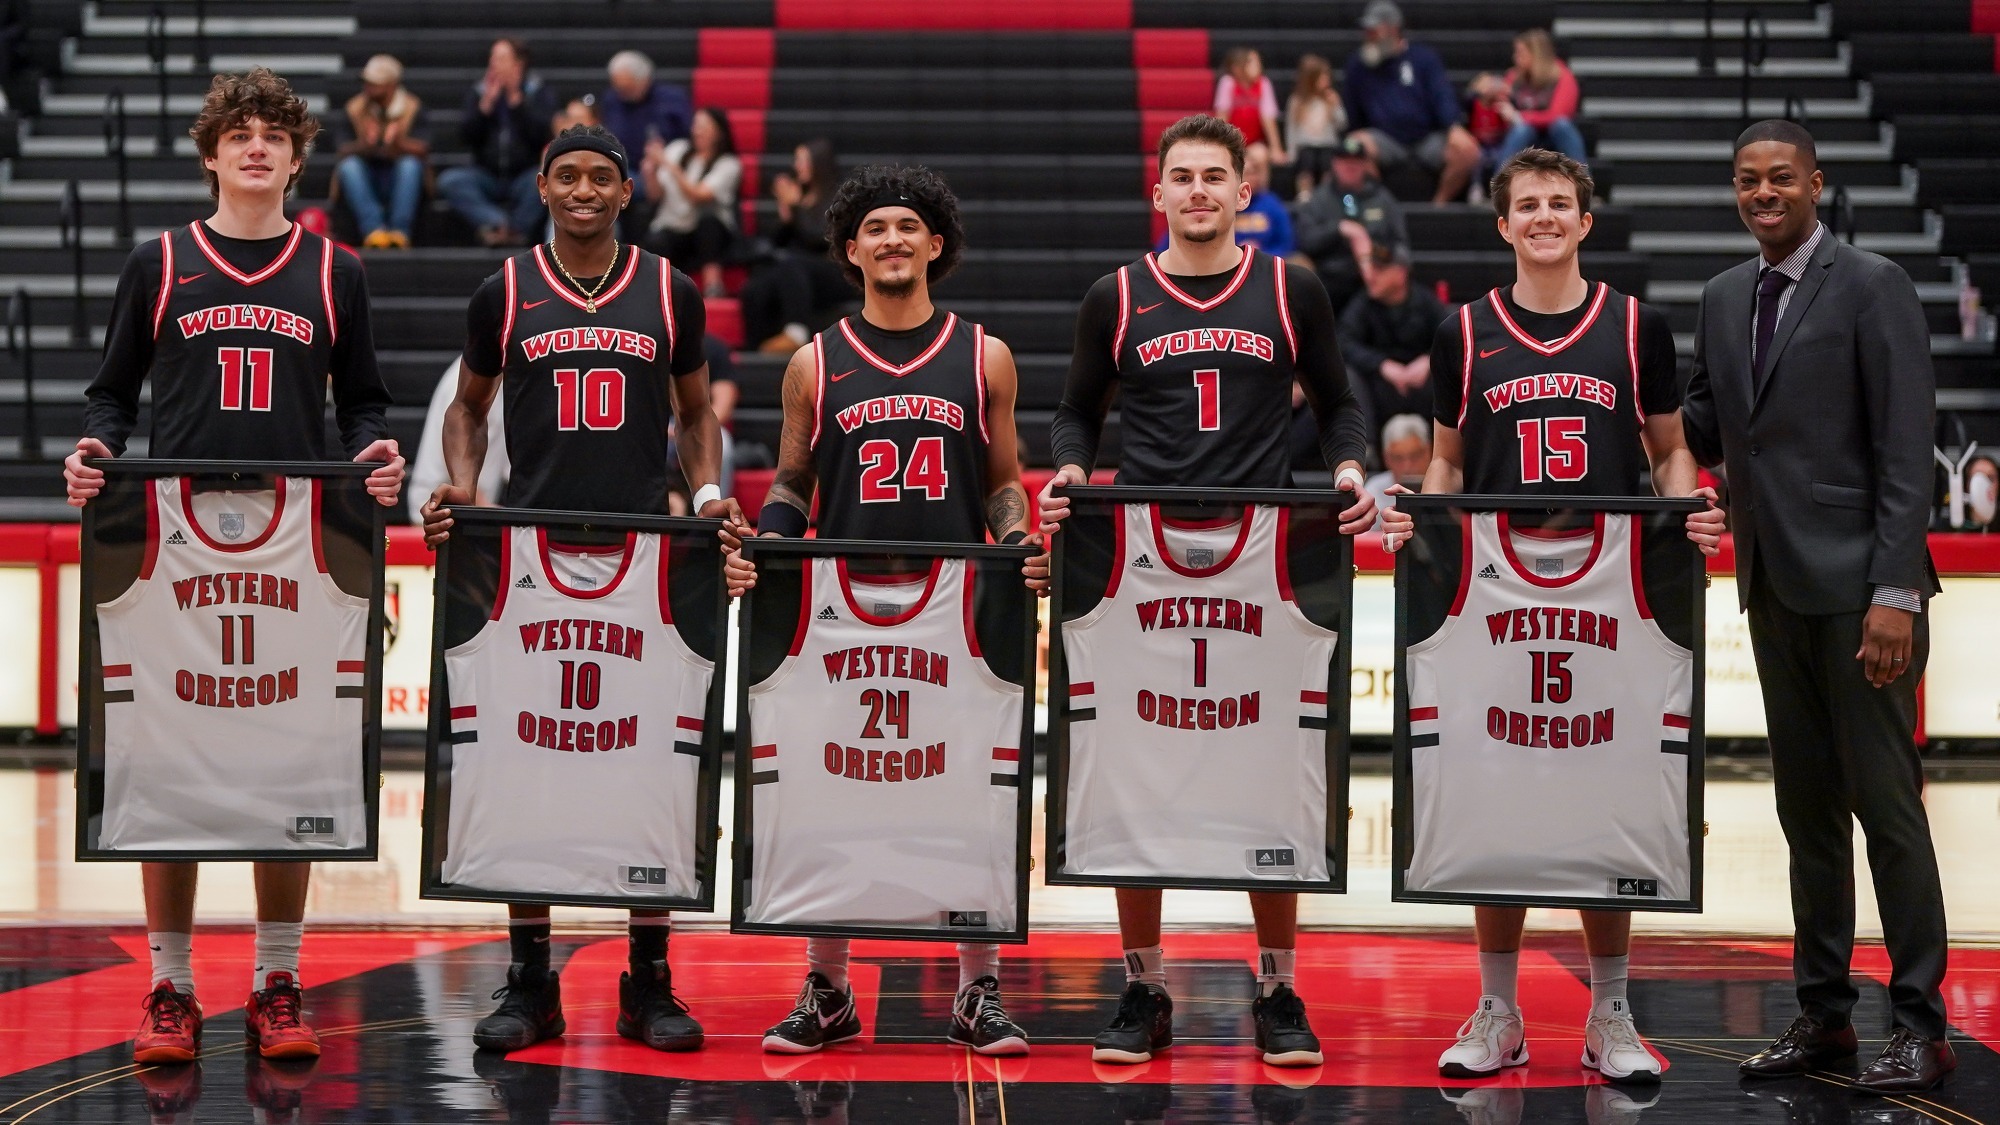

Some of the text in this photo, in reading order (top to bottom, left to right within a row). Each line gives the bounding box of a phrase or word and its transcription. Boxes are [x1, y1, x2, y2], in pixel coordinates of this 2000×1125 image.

[177, 304, 314, 345] WOLVES
[521, 326, 657, 363] WOLVES
[1136, 327, 1274, 366] WOLVES
[217, 346, 274, 412] 11
[553, 367, 626, 431] 10
[1193, 368, 1221, 432] 1
[1483, 373, 1617, 414] WOLVES
[835, 394, 964, 435] WOLVES
[858, 436, 948, 504] 24
[1516, 416, 1588, 484] 15
[172, 571, 299, 613] WESTERN
[1135, 596, 1263, 638] WESTERN
[1485, 606, 1619, 652] WESTERN
[217, 614, 255, 665] 11
[518, 618, 644, 662] WESTERN
[558, 659, 601, 711] 10
[822, 644, 949, 688] WESTERN
[1190, 638, 1207, 688] 1
[1527, 651, 1574, 704] 15
[175, 666, 298, 709] OREGON
[1137, 688, 1261, 731] OREGON
[517, 710, 638, 753] OREGON
[859, 688, 911, 739] 24
[1486, 706, 1615, 750] OREGON
[824, 741, 946, 783] OREGON
